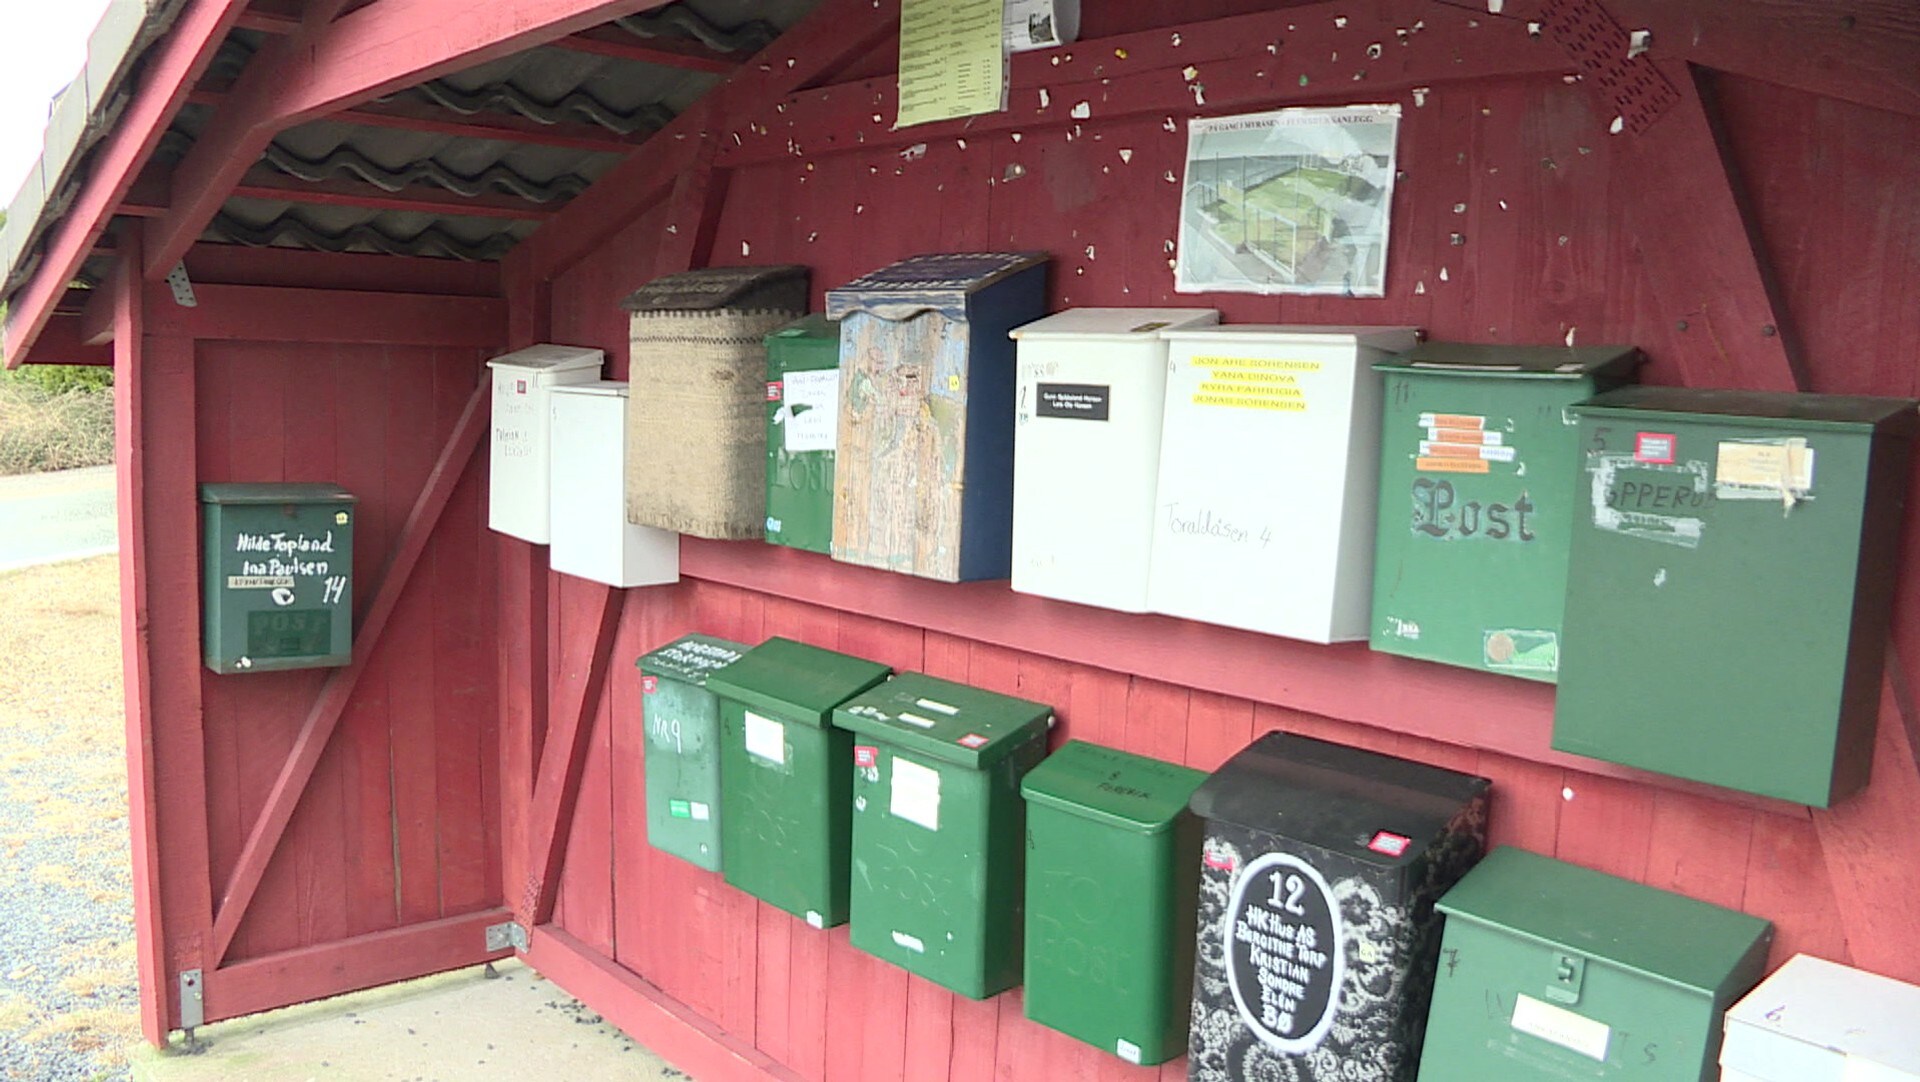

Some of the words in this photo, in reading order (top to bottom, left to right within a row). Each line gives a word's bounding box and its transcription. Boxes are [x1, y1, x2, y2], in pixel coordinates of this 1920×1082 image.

[1412, 477, 1536, 542] Post
[270, 530, 335, 557] Topland
[1259, 525, 1272, 549] 4
[269, 557, 328, 576] Paulsen
[322, 575, 346, 604] 14
[1267, 870, 1306, 917] 12
[1295, 924, 1317, 948] AS
[1250, 942, 1310, 984] KRISTIAN
[1443, 948, 1460, 977] 7
[1261, 984, 1297, 1013] ELIN
